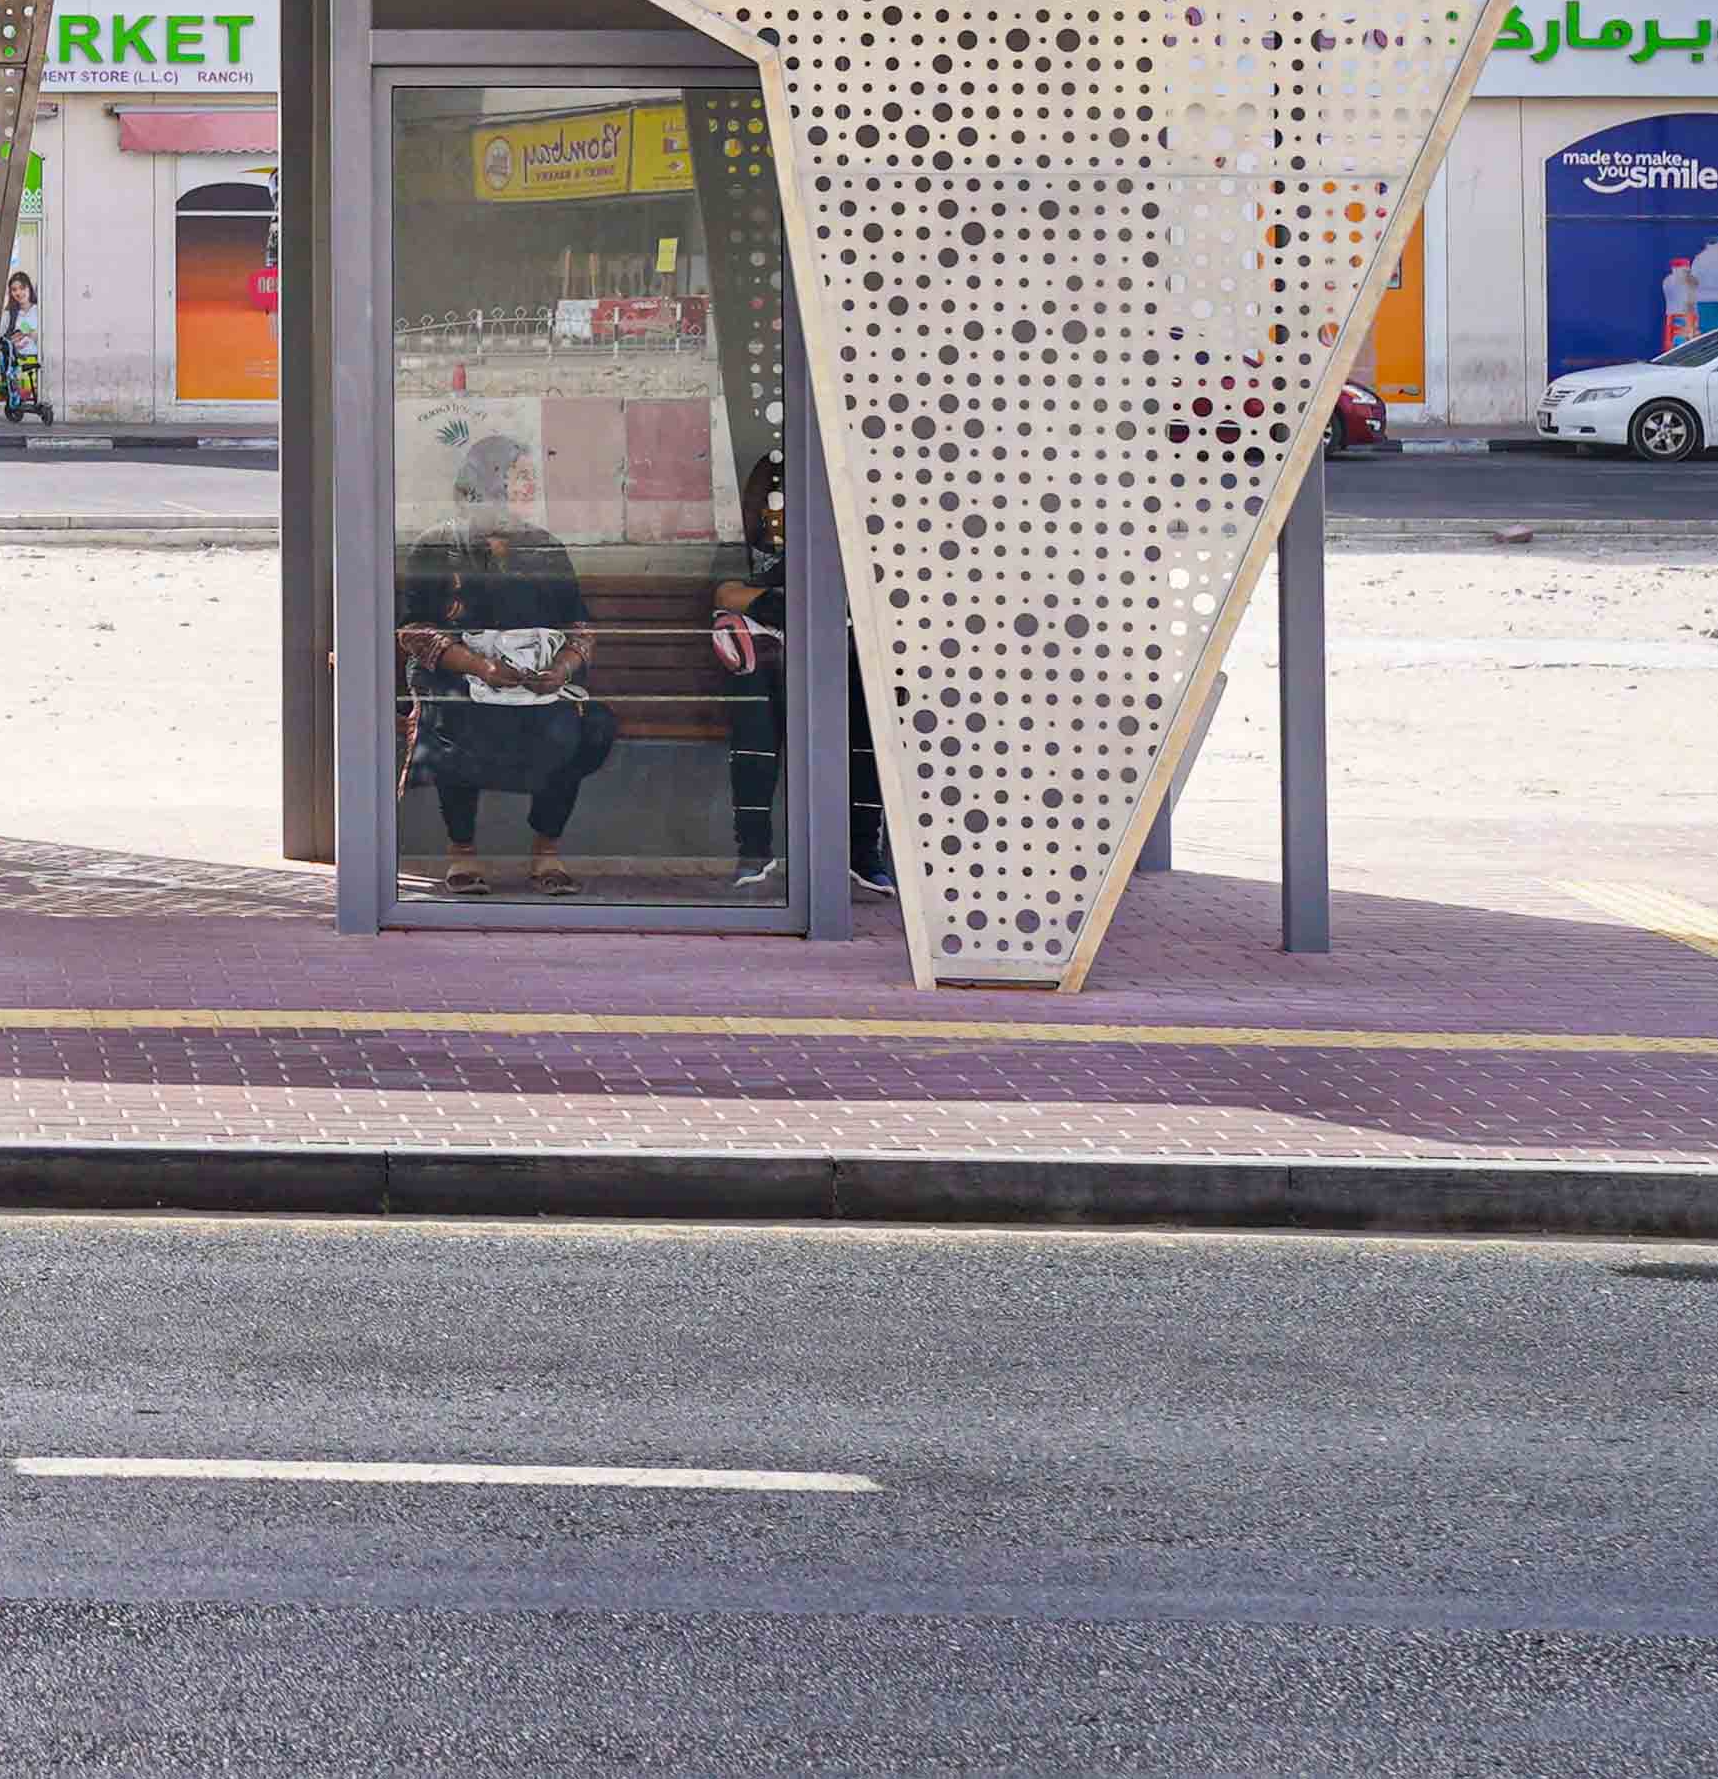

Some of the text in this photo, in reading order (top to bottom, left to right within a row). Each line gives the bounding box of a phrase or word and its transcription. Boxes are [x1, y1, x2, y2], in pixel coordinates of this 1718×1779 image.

[41, 14, 255, 63] RKET
[1492, 0, 1718, 63] برمارك
[43, 70, 75, 83] ENT
[80, 70, 129, 83] STORE
[197, 70, 254, 85] RANCH)
[1563, 149, 1682, 166] made to make
[1596, 158, 1718, 190] you smile
